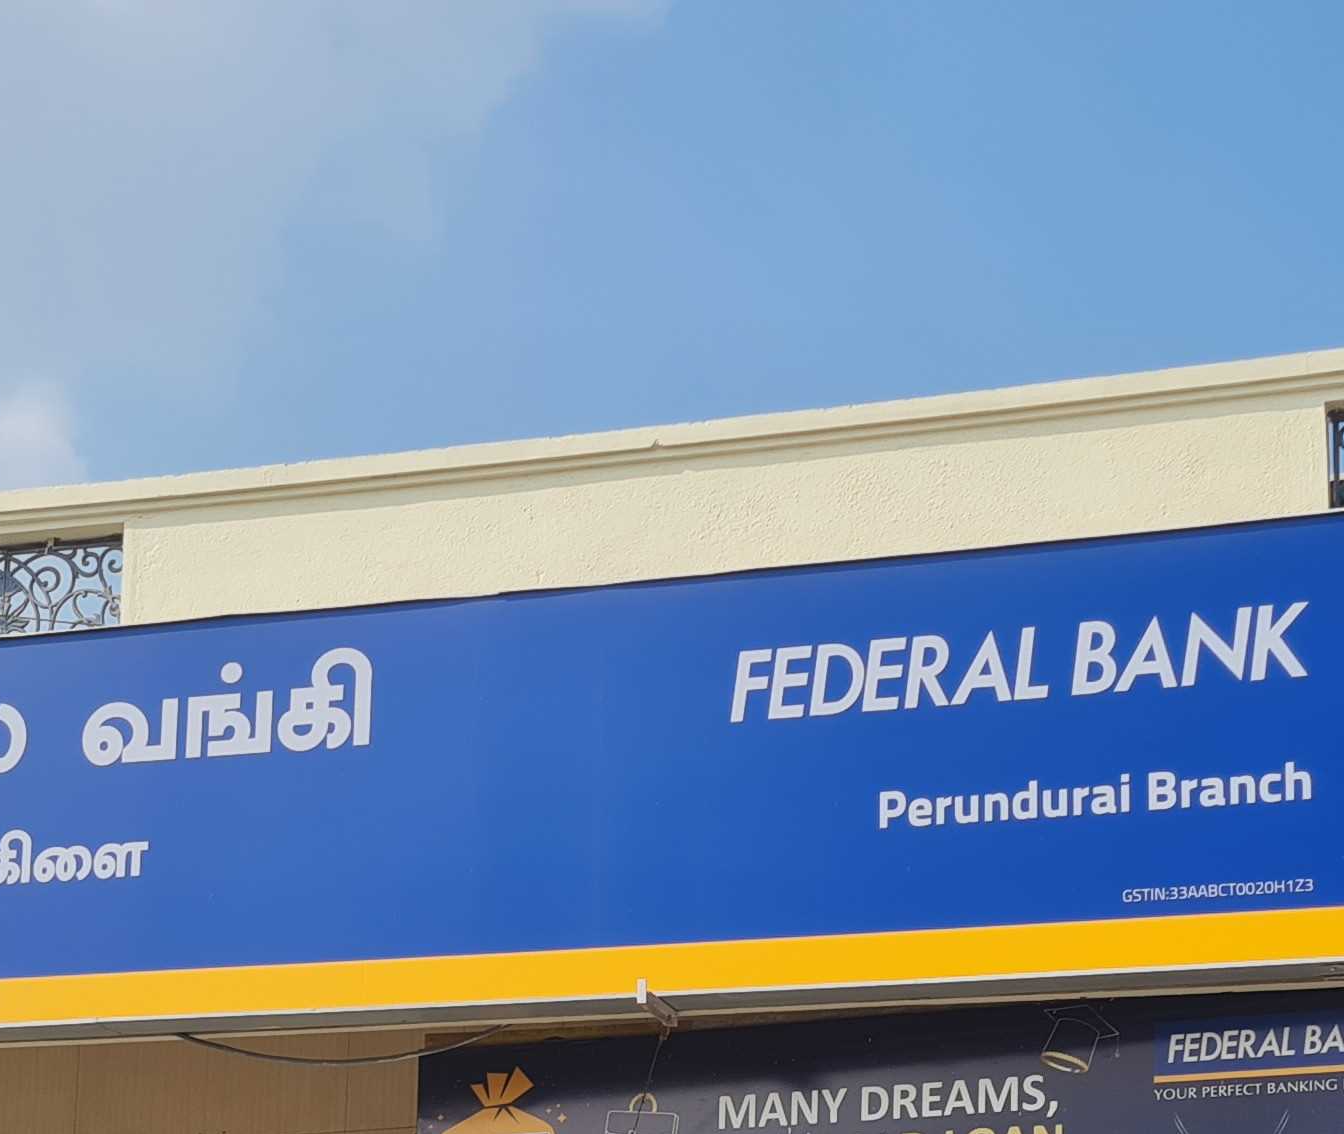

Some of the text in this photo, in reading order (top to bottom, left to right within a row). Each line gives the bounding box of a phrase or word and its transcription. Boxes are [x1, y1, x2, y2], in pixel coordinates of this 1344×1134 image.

[730, 601, 1309, 723] FEDERAL BANK
[82, 647, 373, 766] வங்கி
[878, 761, 1312, 829] Perundurai Branch
[1167, 1027, 1296, 1064] FEDERAL
[718, 1074, 1059, 1130] MANY DREAMS,
[1154, 1087, 1198, 1101] YOUR
[1202, 1082, 1262, 1098] PERFECT
[1267, 1078, 1338, 1095] BANKING
